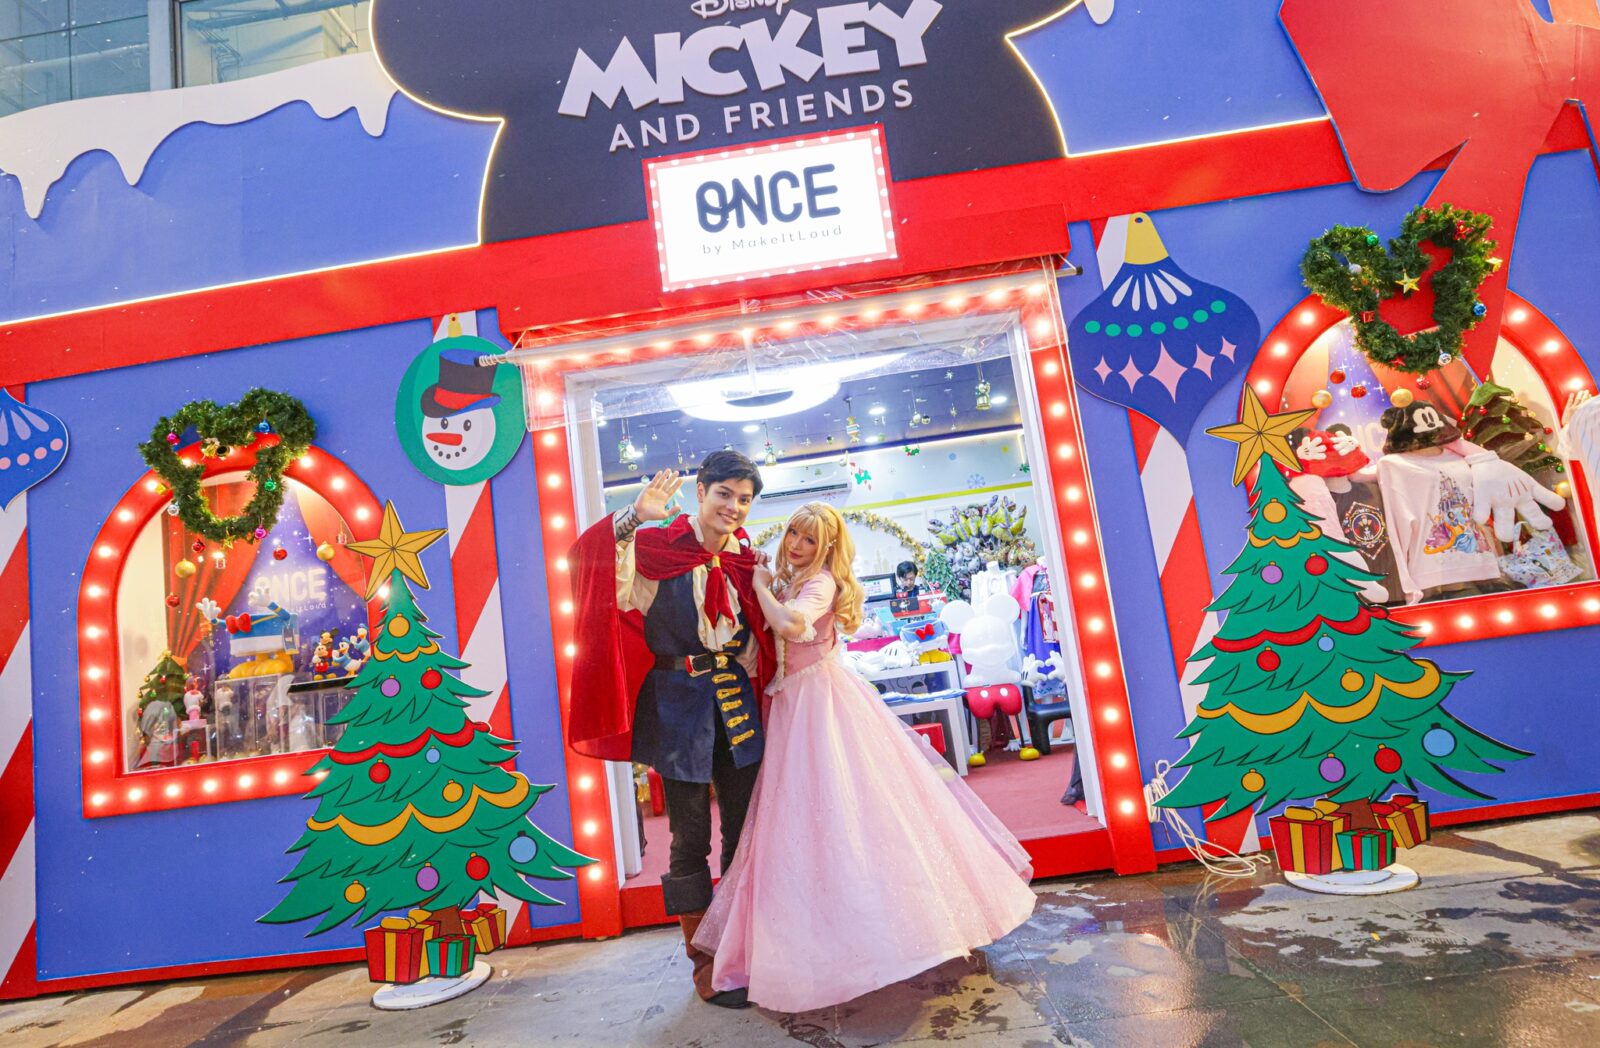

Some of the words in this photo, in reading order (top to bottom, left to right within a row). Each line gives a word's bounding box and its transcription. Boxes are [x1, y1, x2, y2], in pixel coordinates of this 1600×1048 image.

[558, 0, 943, 117] MICKEY
[609, 113, 700, 152] AND
[724, 79, 913, 134] FRIENDS
[696, 163, 841, 233] ONCE
[703, 244, 722, 255] by
[732, 225, 842, 250] MakeItLoud
